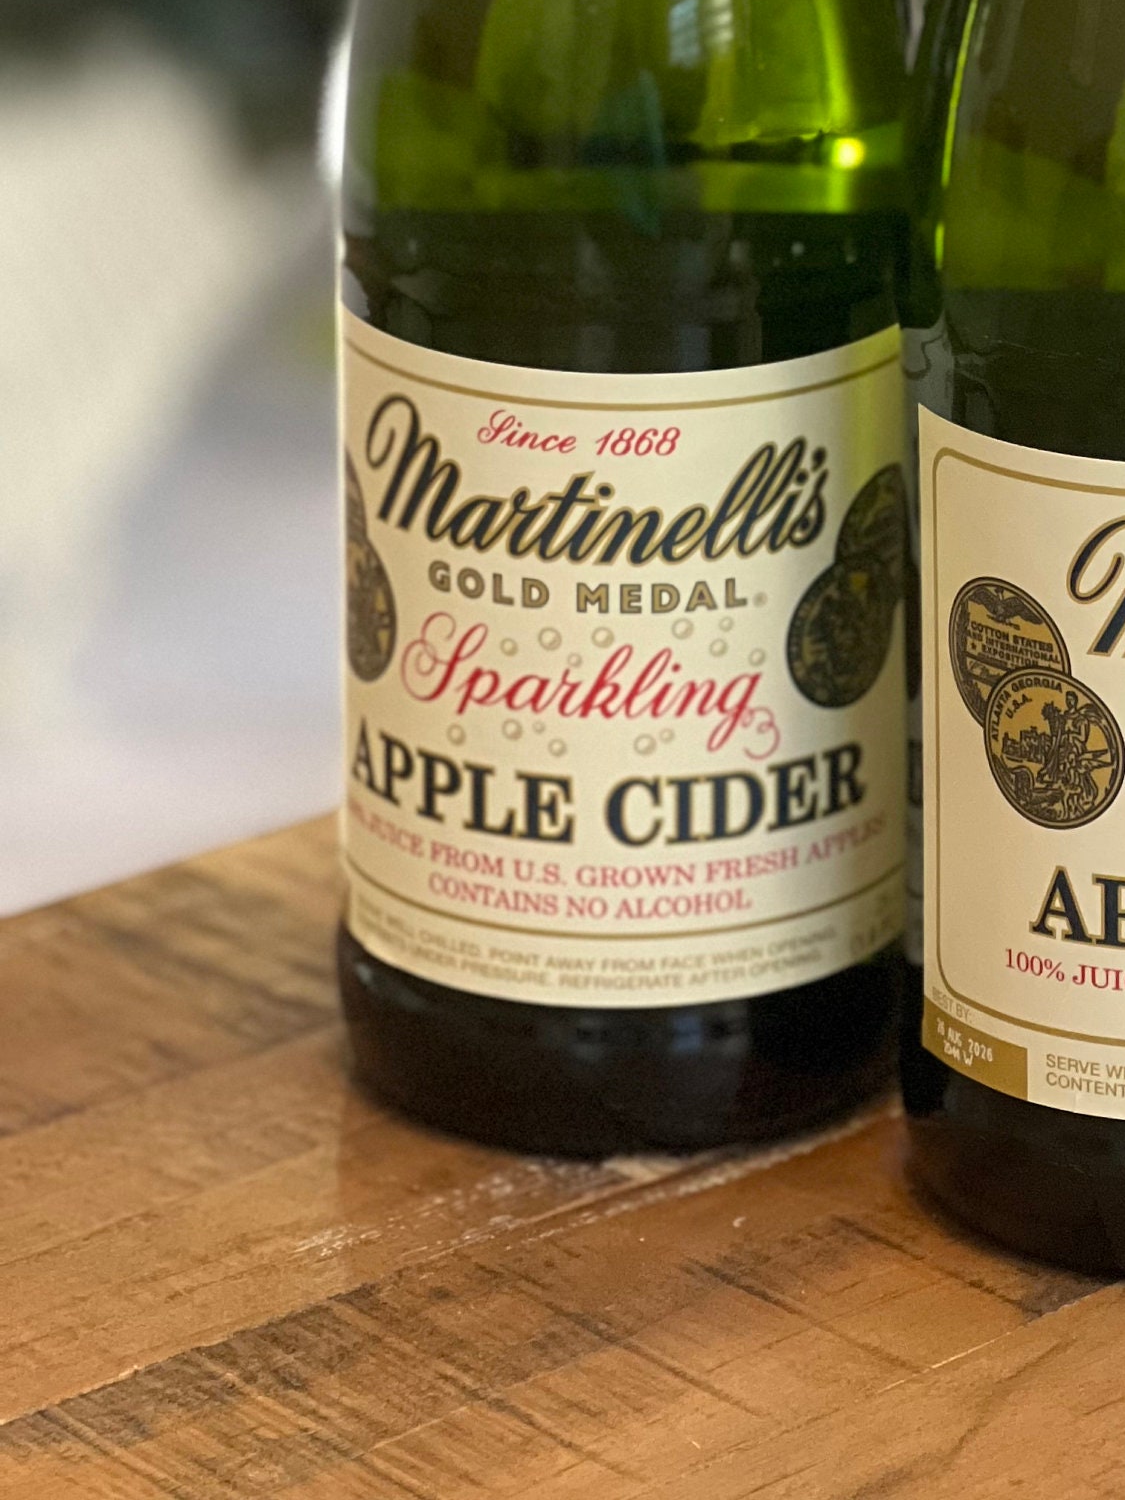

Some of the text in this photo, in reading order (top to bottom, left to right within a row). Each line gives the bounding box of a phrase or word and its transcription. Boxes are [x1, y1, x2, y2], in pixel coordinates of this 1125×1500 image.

[477, 408, 681, 457] Since 1868
[366, 393, 830, 566] Martinelli's
[428, 560, 749, 615] GOLD MEDAL
[970, 620, 1054, 653] COTTON STATES
[981, 642, 1039, 667] EXPOSITION
[985, 635, 1061, 665] INTERNATIONAL
[401, 612, 781, 761] Sparkling
[990, 678, 1063, 742] ATLANTA GEORGIA
[351, 716, 867, 846] APPLE CIDER
[430, 840, 503, 878] FROM
[514, 858, 567, 886] U.S.
[575, 863, 695, 889] GROWN
[706, 846, 799, 883] FRESH
[428, 872, 752, 920] CONTAINS NO ALCOHOL
[544, 953, 595, 971] AWAY
[601, 954, 655, 972] FROM
[660, 951, 704, 971] FACE
[687, 964, 745, 987] AFTER
[1005, 948, 1065, 985] 100%
[967, 1038, 993, 1062] 2026
[1046, 1053, 1100, 1077] SERVE
